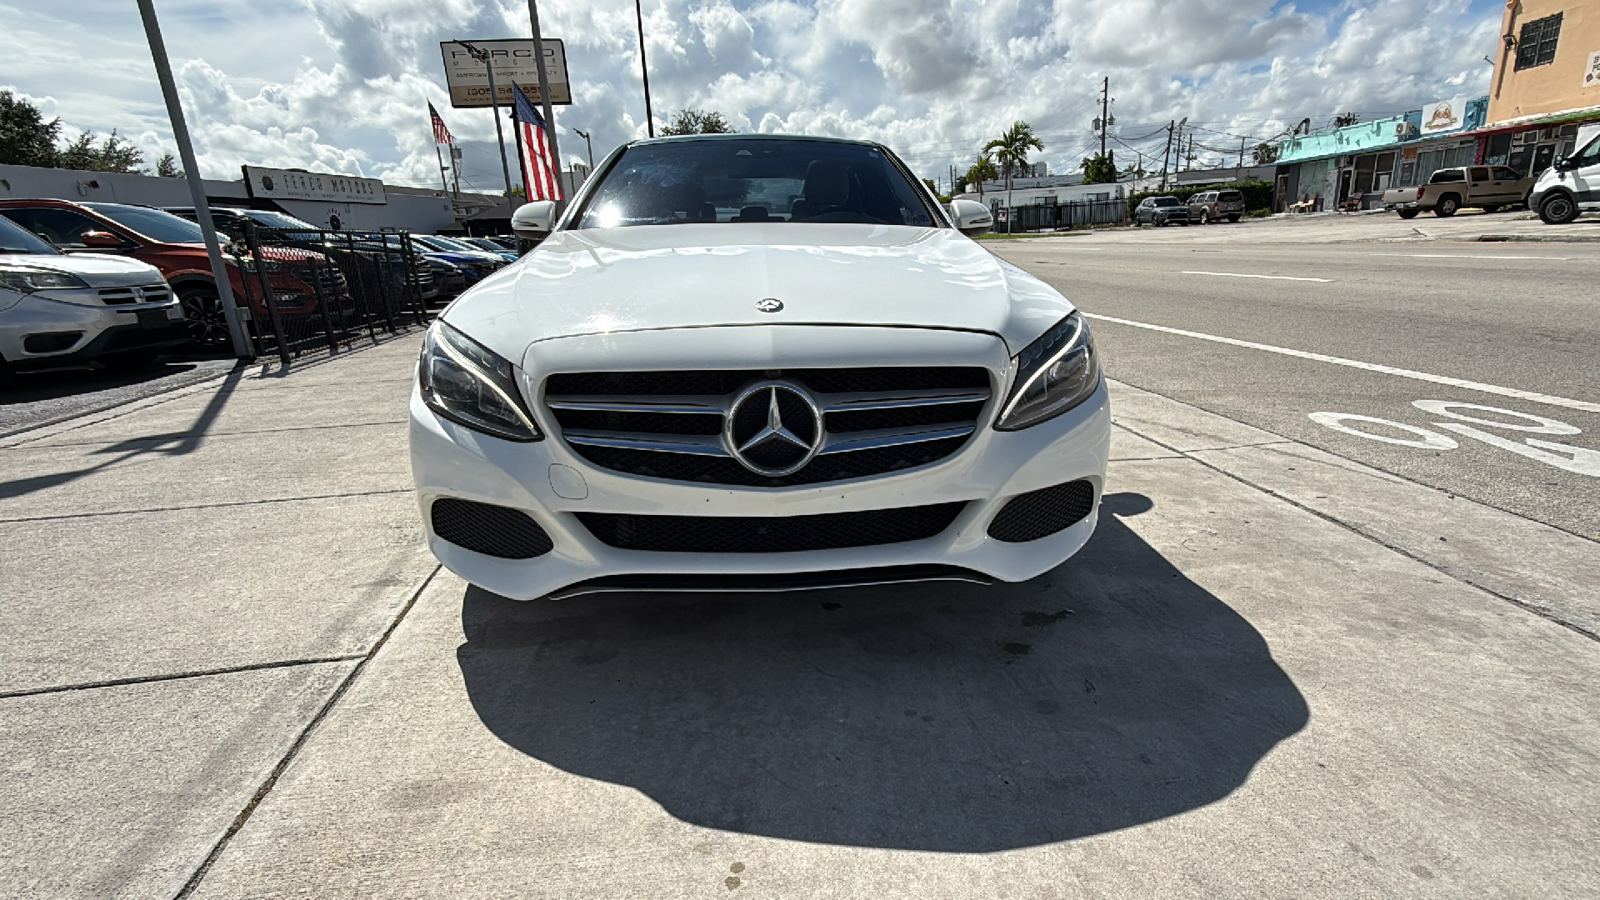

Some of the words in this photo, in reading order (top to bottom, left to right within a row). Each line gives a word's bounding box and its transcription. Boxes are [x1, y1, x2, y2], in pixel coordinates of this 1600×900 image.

[451, 48, 555, 59] FRCO
[283, 174, 323, 191] FERCO
[331, 179, 374, 195] MOTORS
